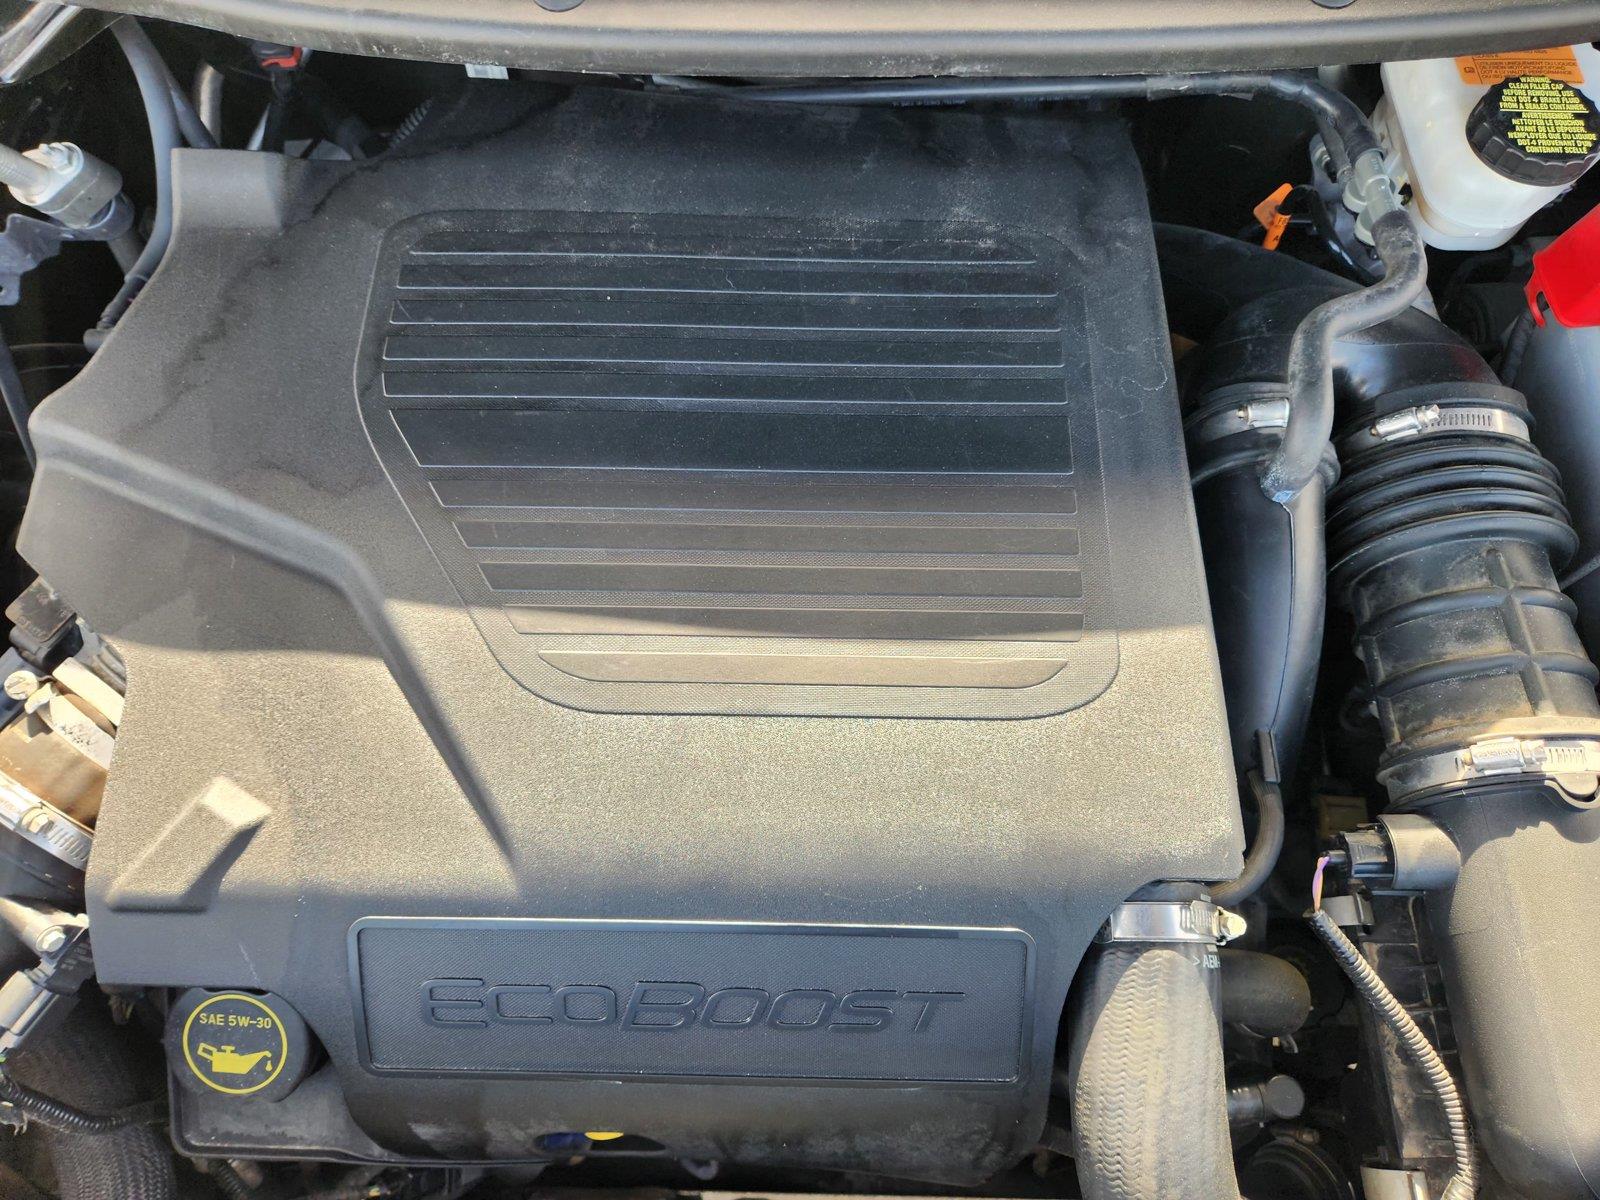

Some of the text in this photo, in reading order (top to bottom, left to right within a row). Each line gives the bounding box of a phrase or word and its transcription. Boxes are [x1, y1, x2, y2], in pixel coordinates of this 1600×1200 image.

[1525, 102, 1549, 110] SEALED
[1521, 112, 1575, 120] AVERTISSEMENT:
[1512, 118, 1545, 126] NETTOYER
[1553, 119, 1585, 127] BOUCHON
[1548, 132, 1561, 140] QUE
[1562, 132, 1572, 140] DU
[1517, 138, 1530, 146] DOT
[1537, 139, 1576, 147] PROVENANT
[1525, 146, 1563, 154] CONTENANT
[199, 1012, 272, 1029] SAE 5W-30
